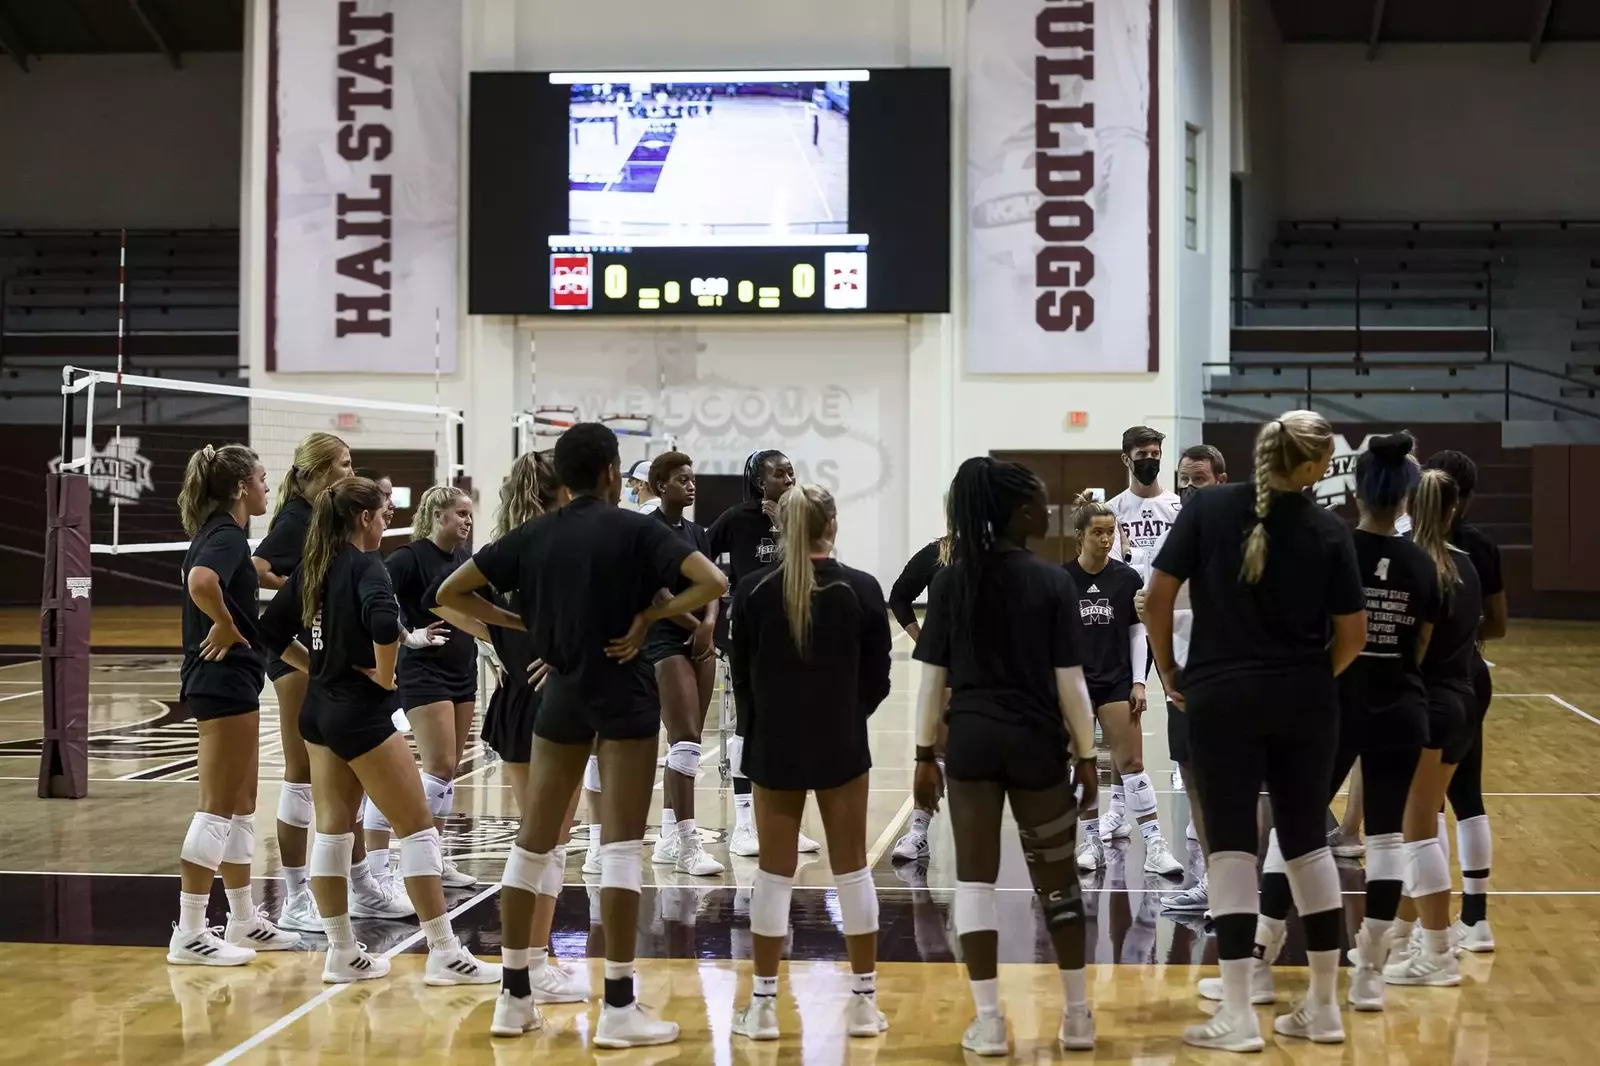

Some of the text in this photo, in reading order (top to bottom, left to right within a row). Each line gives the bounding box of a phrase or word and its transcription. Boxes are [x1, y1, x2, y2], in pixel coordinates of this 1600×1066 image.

[1035, 0, 1095, 332] ULLDOGS
[336, 174, 392, 338] HAIL
[1082, 606, 1108, 617] STATE
